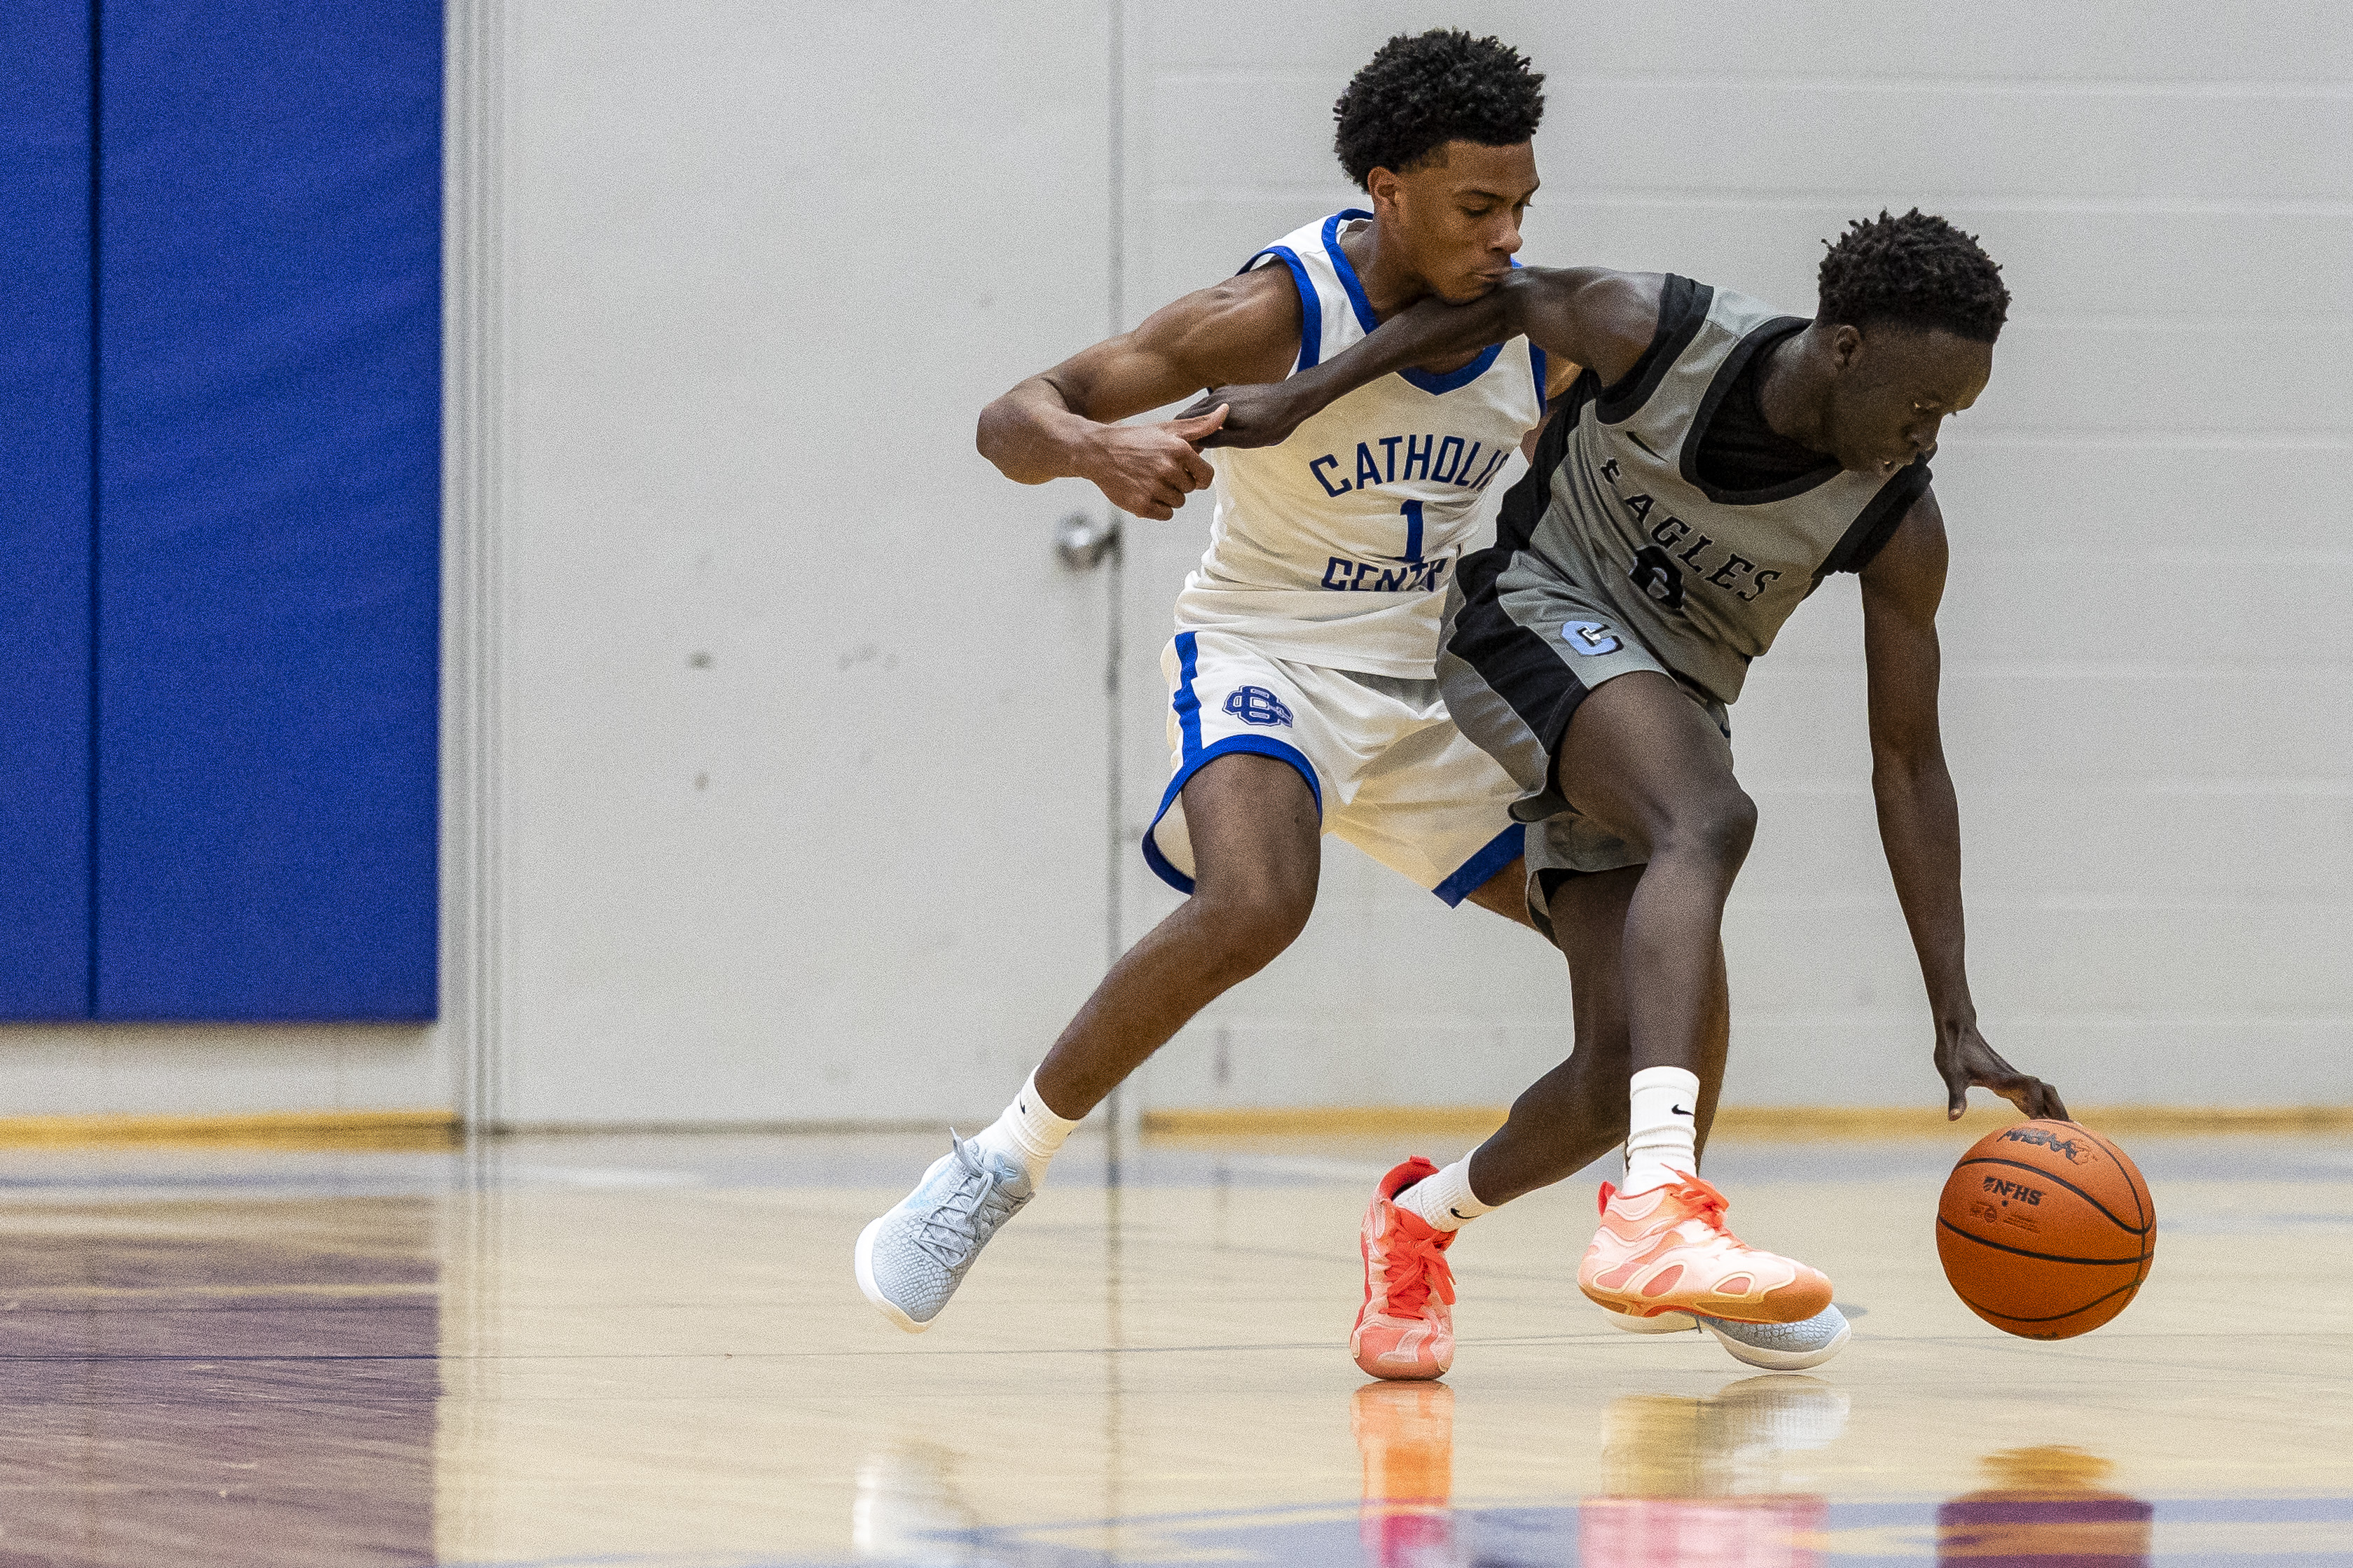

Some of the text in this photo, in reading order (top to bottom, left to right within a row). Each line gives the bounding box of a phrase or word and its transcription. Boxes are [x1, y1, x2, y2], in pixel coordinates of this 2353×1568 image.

[1397, 499, 1425, 562] 1
[1600, 457, 1781, 602] EAGLES
[1992, 1179, 2043, 1207] NFHS
